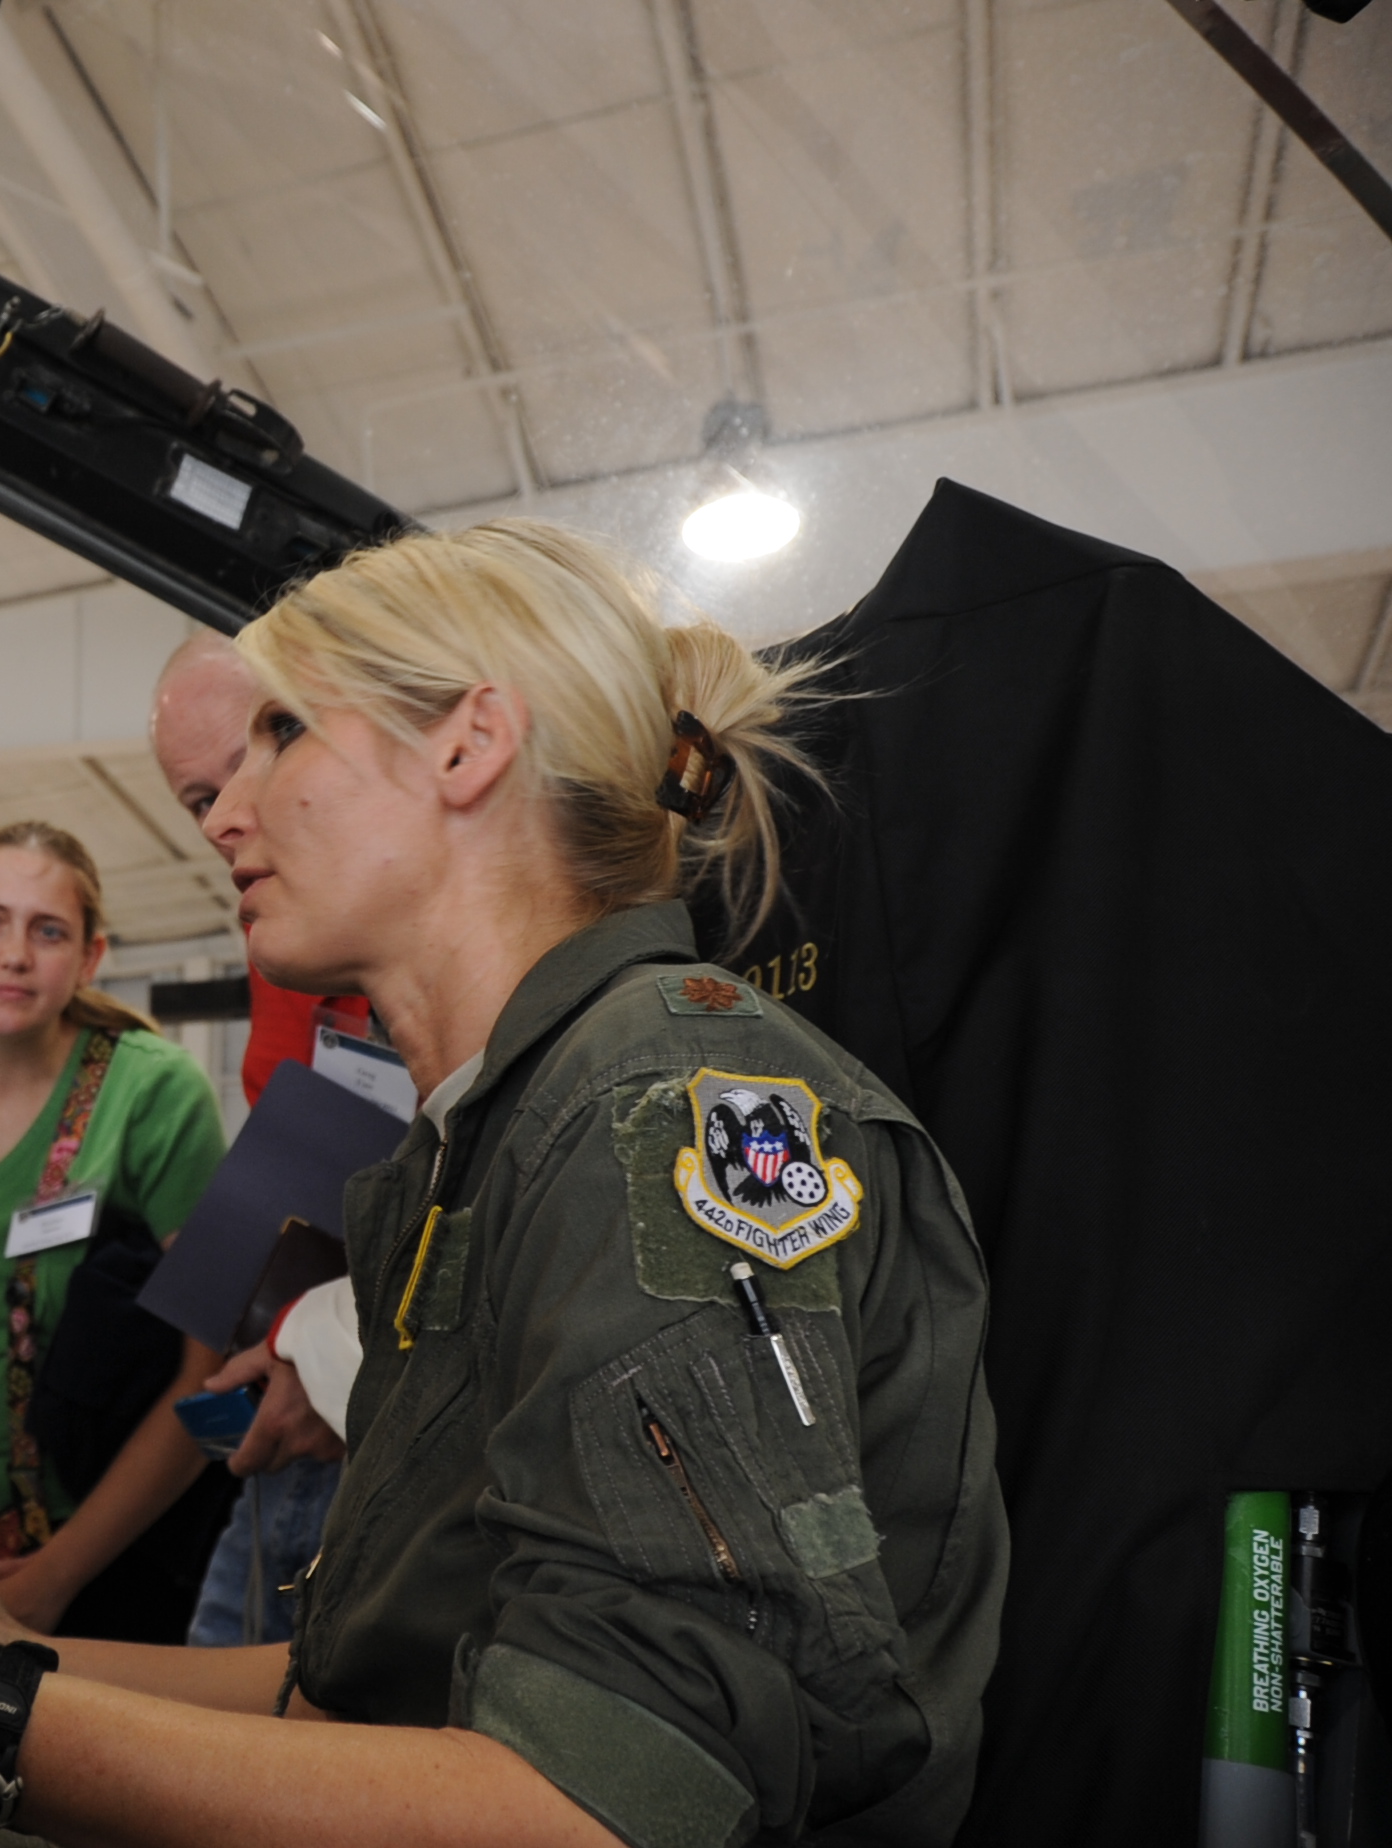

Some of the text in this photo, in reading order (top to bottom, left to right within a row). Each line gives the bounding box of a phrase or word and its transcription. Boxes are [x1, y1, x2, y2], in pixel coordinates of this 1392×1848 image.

[735, 1219, 812, 1257] FIGHTER
[807, 1202, 851, 1236] WING
[1252, 1529, 1270, 1712] BREATHING OXYGEN
[1270, 1536, 1283, 1712] NON-SHATTERABLE
